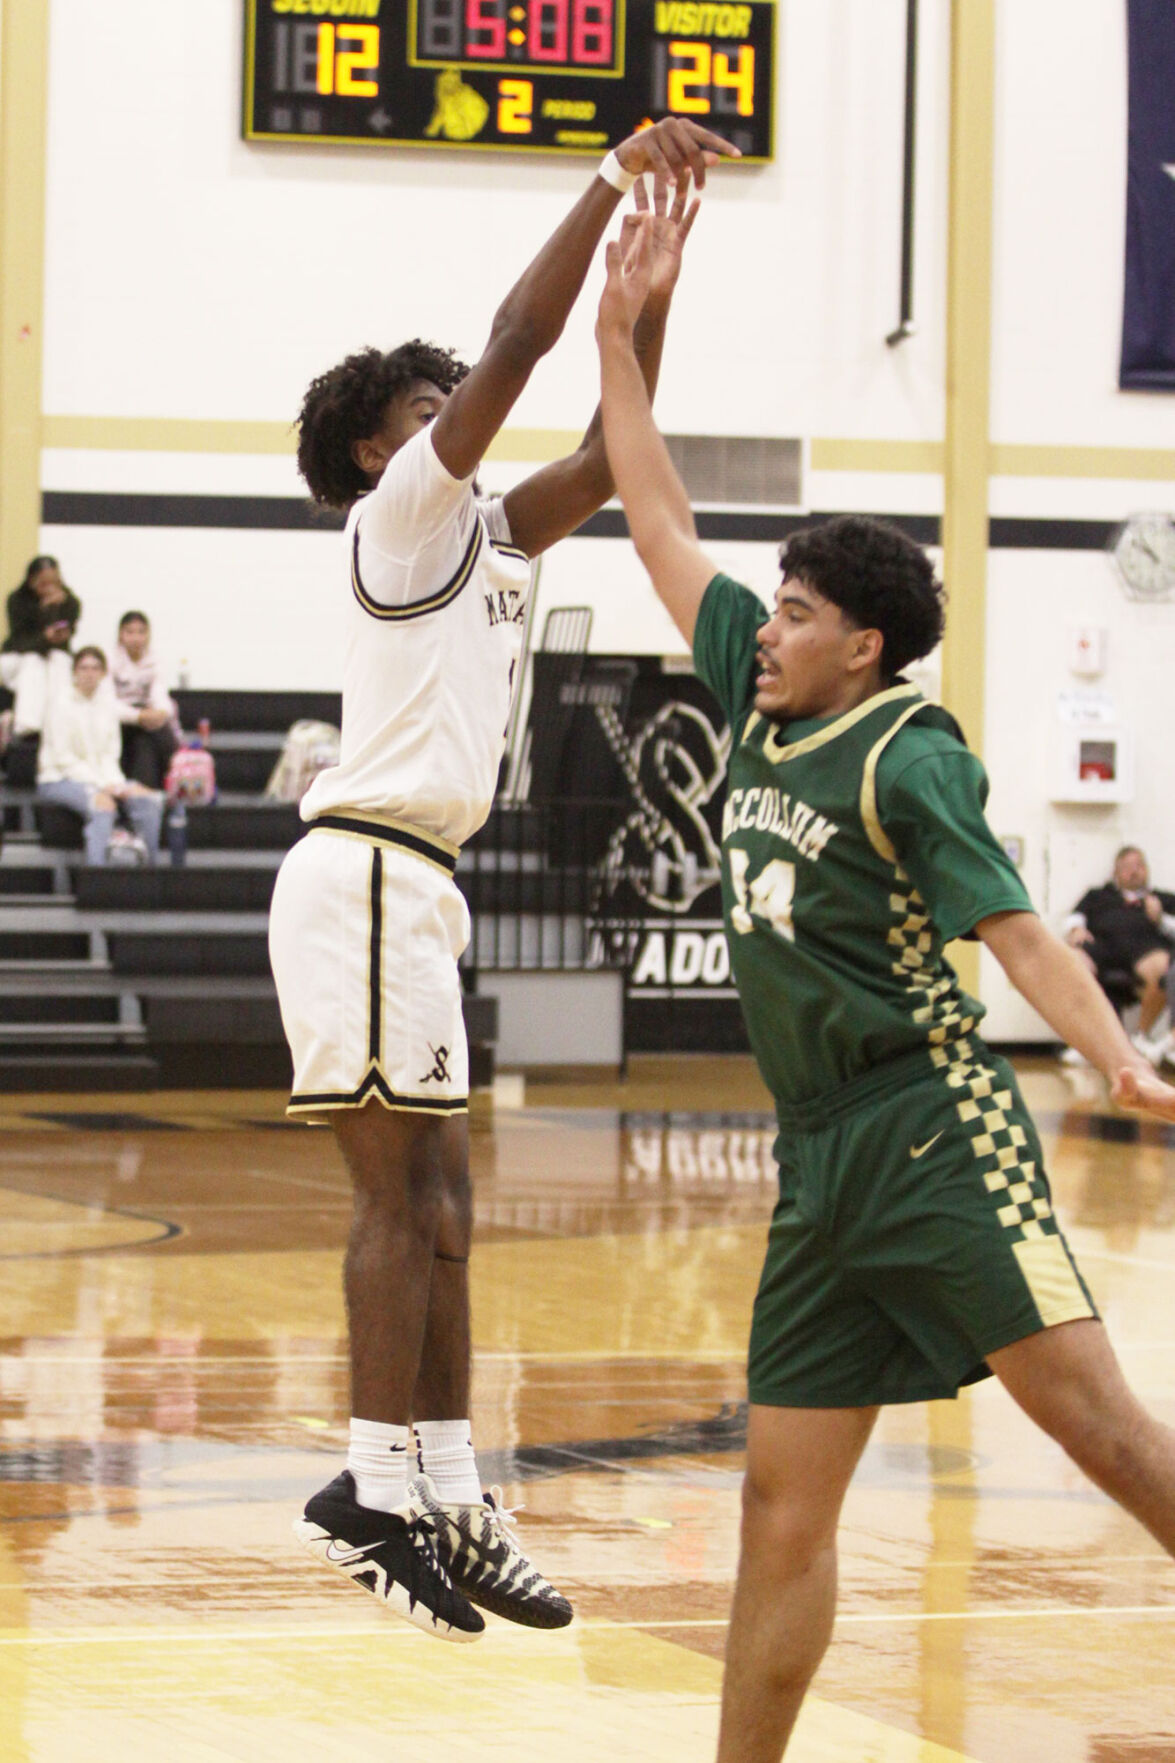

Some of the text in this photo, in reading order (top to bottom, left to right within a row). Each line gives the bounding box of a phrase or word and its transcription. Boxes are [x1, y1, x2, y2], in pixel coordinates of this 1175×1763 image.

[466, 0, 612, 64] 5:08
[654, 1, 752, 38] VISITOR
[317, 22, 380, 97] 12
[668, 41, 755, 117] 24
[498, 79, 534, 134] 2
[729, 847, 796, 944] 14
